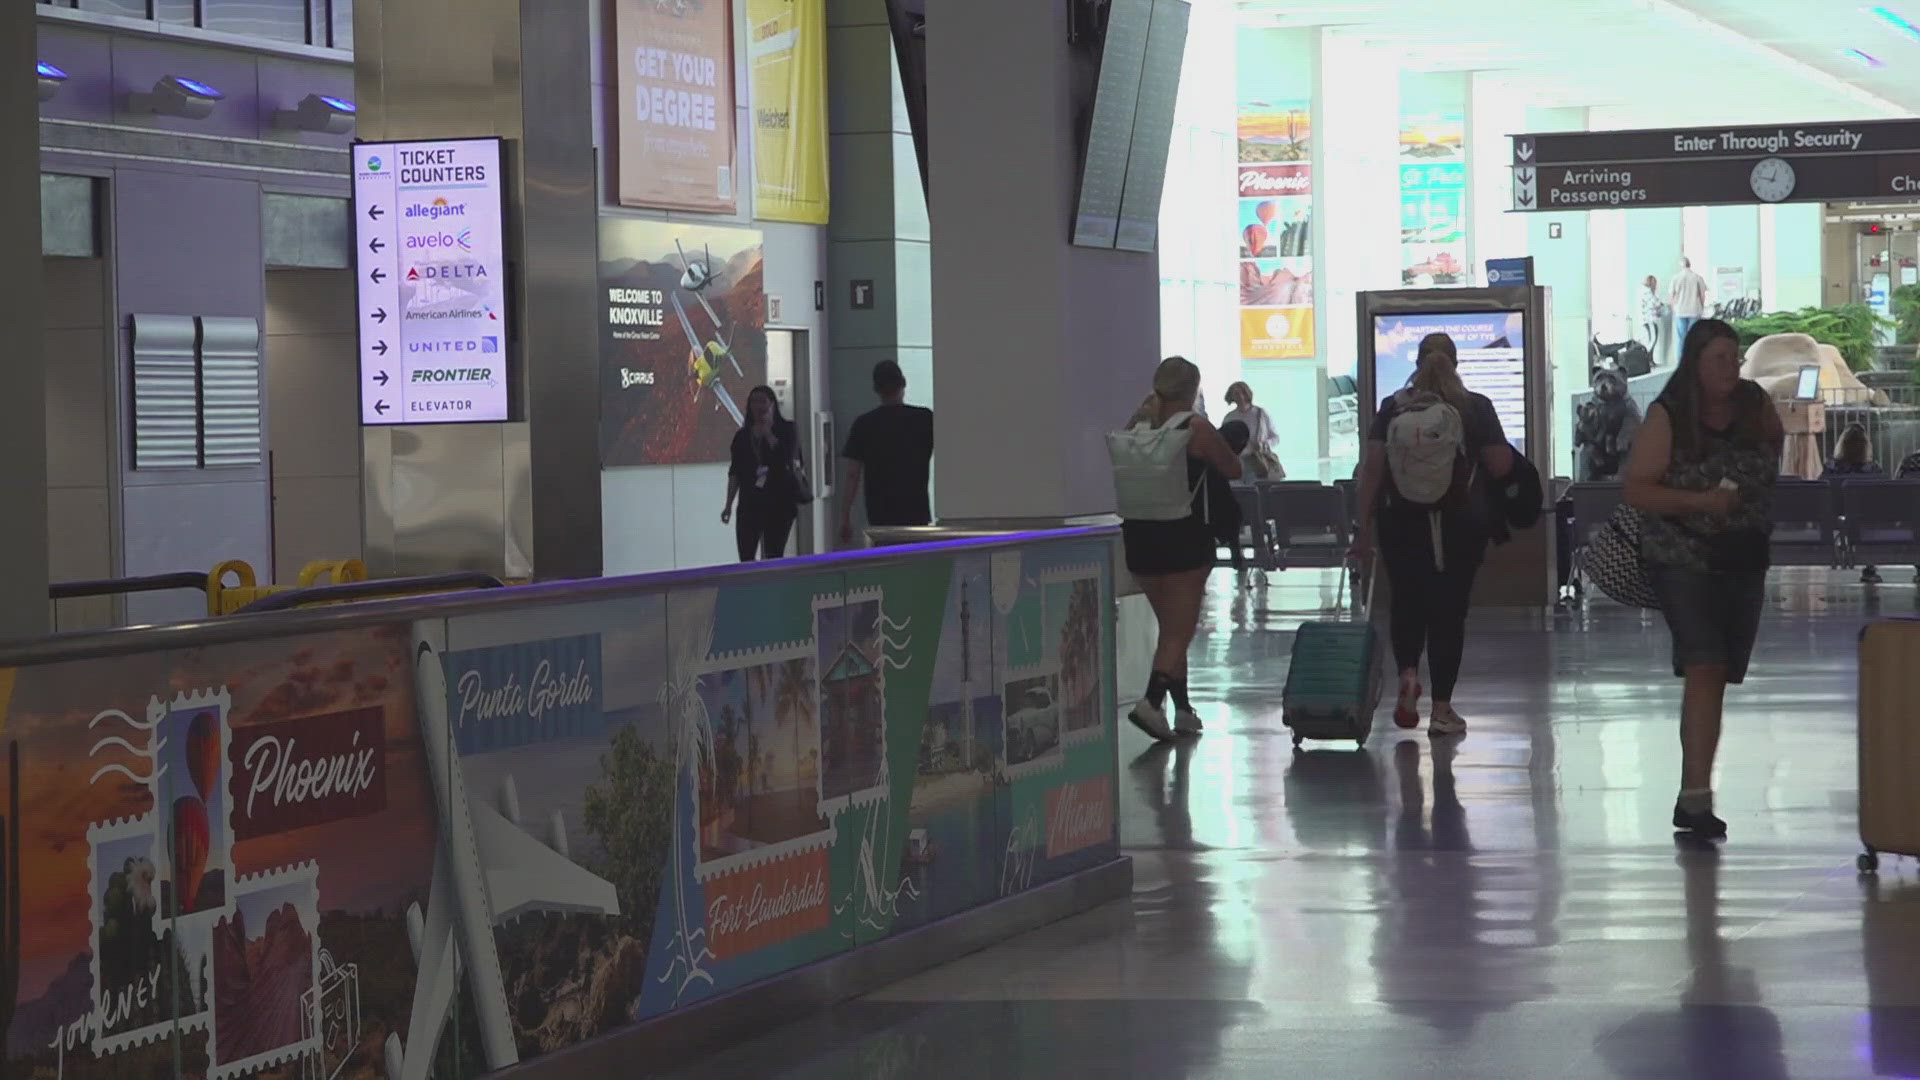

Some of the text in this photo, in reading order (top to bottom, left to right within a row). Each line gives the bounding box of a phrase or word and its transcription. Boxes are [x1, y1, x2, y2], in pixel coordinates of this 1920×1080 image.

[634, 46, 716, 87] GET YOUR
[636, 84, 716, 131] DEGREE
[1674, 129, 1863, 153] Enter Through Security
[400, 149, 456, 166] TICKET
[400, 166, 486, 184] COUNTERS
[1239, 170, 1310, 192] Phoenix
[1563, 168, 1632, 187] Arriving
[1550, 187, 1647, 205] Passengers
[405, 202, 466, 220] allegiant
[406, 231, 454, 249] avelo
[426, 264, 488, 279] DELTA
[609, 287, 662, 304] WELCOME TO
[405, 309, 482, 321] American Airlines
[609, 306, 664, 326] KNOXVILLE
[409, 341, 477, 352] UNITED
[411, 368, 491, 383] FRONTIER
[629, 371, 655, 385] CIRRUS
[411, 400, 472, 412] ELEVATOR
[457, 659, 593, 729] Punta Gorda
[244, 731, 375, 819] Phoenix
[708, 867, 826, 943] Fort Lauderdale
